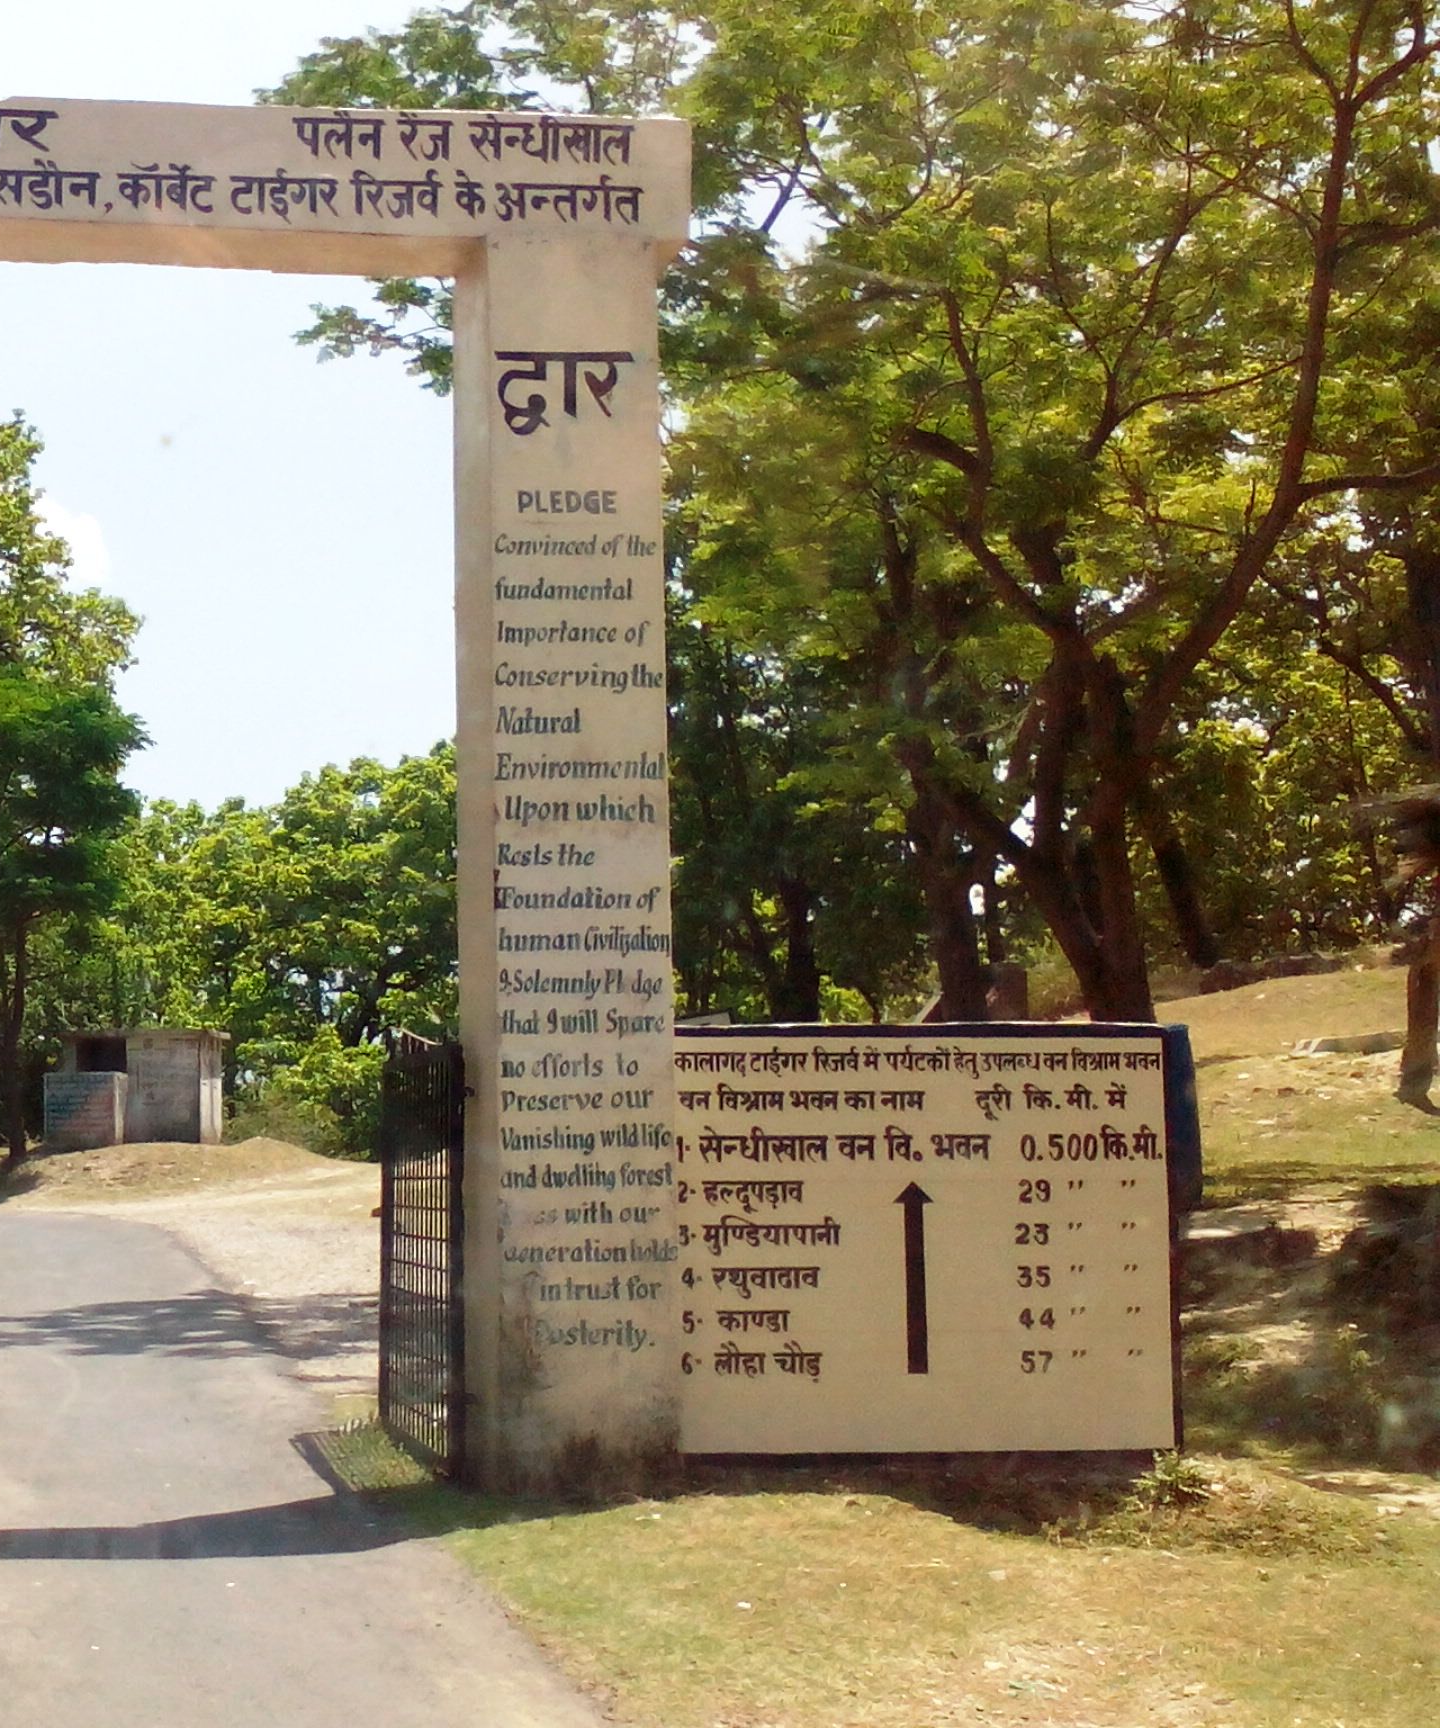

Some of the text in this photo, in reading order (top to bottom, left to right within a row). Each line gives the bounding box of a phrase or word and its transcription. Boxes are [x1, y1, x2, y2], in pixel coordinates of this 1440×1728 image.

[230, 171, 341, 223] टाईगर
[350, 169, 442, 219] रिजर्व
[455, 170, 486, 221] के
[495, 175, 644, 224] अन्तर्गत
[494, 350, 635, 435] द्वार
[517, 490, 618, 514] PLEDGE
[494, 533, 657, 557] Convinced of the
[495, 576, 633, 600] fundamental
[497, 620, 651, 647] Importance of
[494, 662, 664, 694] Conserving the
[495, 706, 581, 735] Natural
[494, 752, 666, 781] Environmental
[504, 794, 657, 827] Upon which
[497, 843, 595, 867] Rests the
[498, 886, 661, 913] Foundation of
[498, 926, 580, 952] human
[501, 1009, 540, 1036] that
[561, 1009, 600, 1035] will
[605, 1007, 666, 1039] Spare
[500, 1052, 639, 1079] no efforts to
[750, 1046, 809, 1078] टाईगर
[811, 1045, 860, 1073] रिजर्व
[862, 1046, 882, 1072] में
[883, 1046, 951, 1072] पर्यटकों
[953, 1046, 978, 1080] हेतु
[979, 1052, 1041, 1072] उपलब्ध
[1043, 1052, 1068, 1072] वन
[1069, 1047, 1121, 1073] विश्राम
[1123, 1052, 1161, 1072] भवन
[501, 1089, 654, 1112] Preserve our
[677, 1091, 711, 1111] वन
[716, 1083, 785, 1112] विश्राम
[789, 1091, 839, 1111] भवन
[843, 1091, 876, 1111] का
[880, 1091, 926, 1111] नाम
[975, 1083, 1012, 1121] दूरी
[1104, 1082, 1127, 1110] में
[500, 1125, 595, 1156] Vanishing
[836, 1135, 876, 1160] वन
[931, 1134, 991, 1160] भवन
[1021, 1134, 1098, 1161] 0.500
[500, 1163, 536, 1188] and
[620, 1162, 673, 1187] forest
[1018, 1179, 1051, 1203] 29
[564, 1201, 613, 1225] with
[1015, 1223, 1049, 1245] 23
[565, 1275, 621, 1300] trust
[626, 1275, 662, 1300] for
[1017, 1266, 1051, 1288] 35
[717, 1307, 1055, 1332] काण्डा 44
[1021, 1350, 1053, 1374] 57
